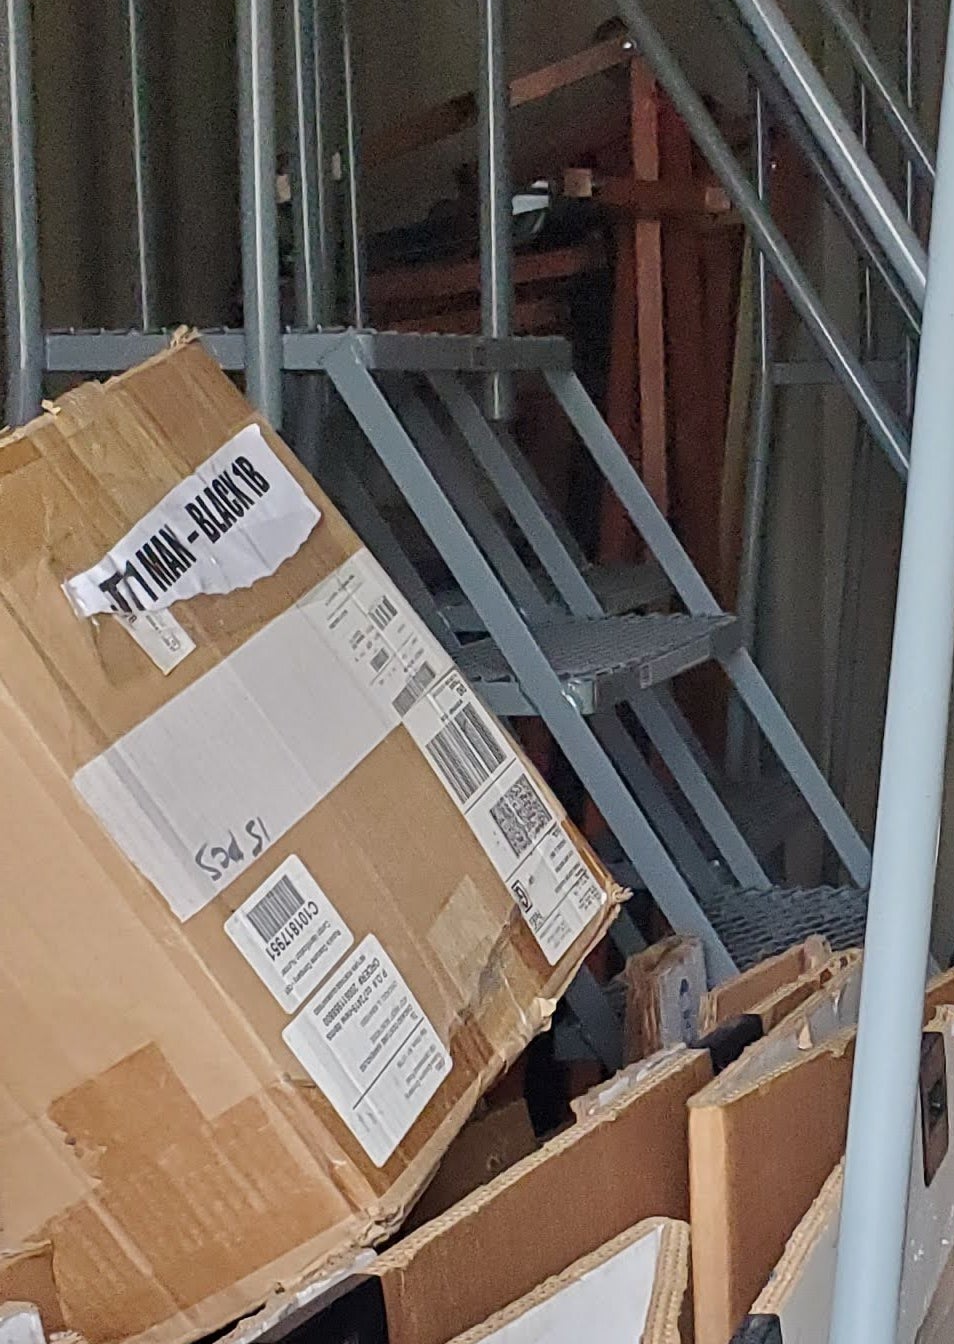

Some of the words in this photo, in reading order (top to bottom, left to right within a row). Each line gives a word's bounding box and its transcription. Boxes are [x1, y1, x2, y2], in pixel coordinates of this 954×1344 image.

[135, 523, 197, 593] MAN
[184, 470, 256, 544] BLACK
[264, 898, 320, 962] C101817951
